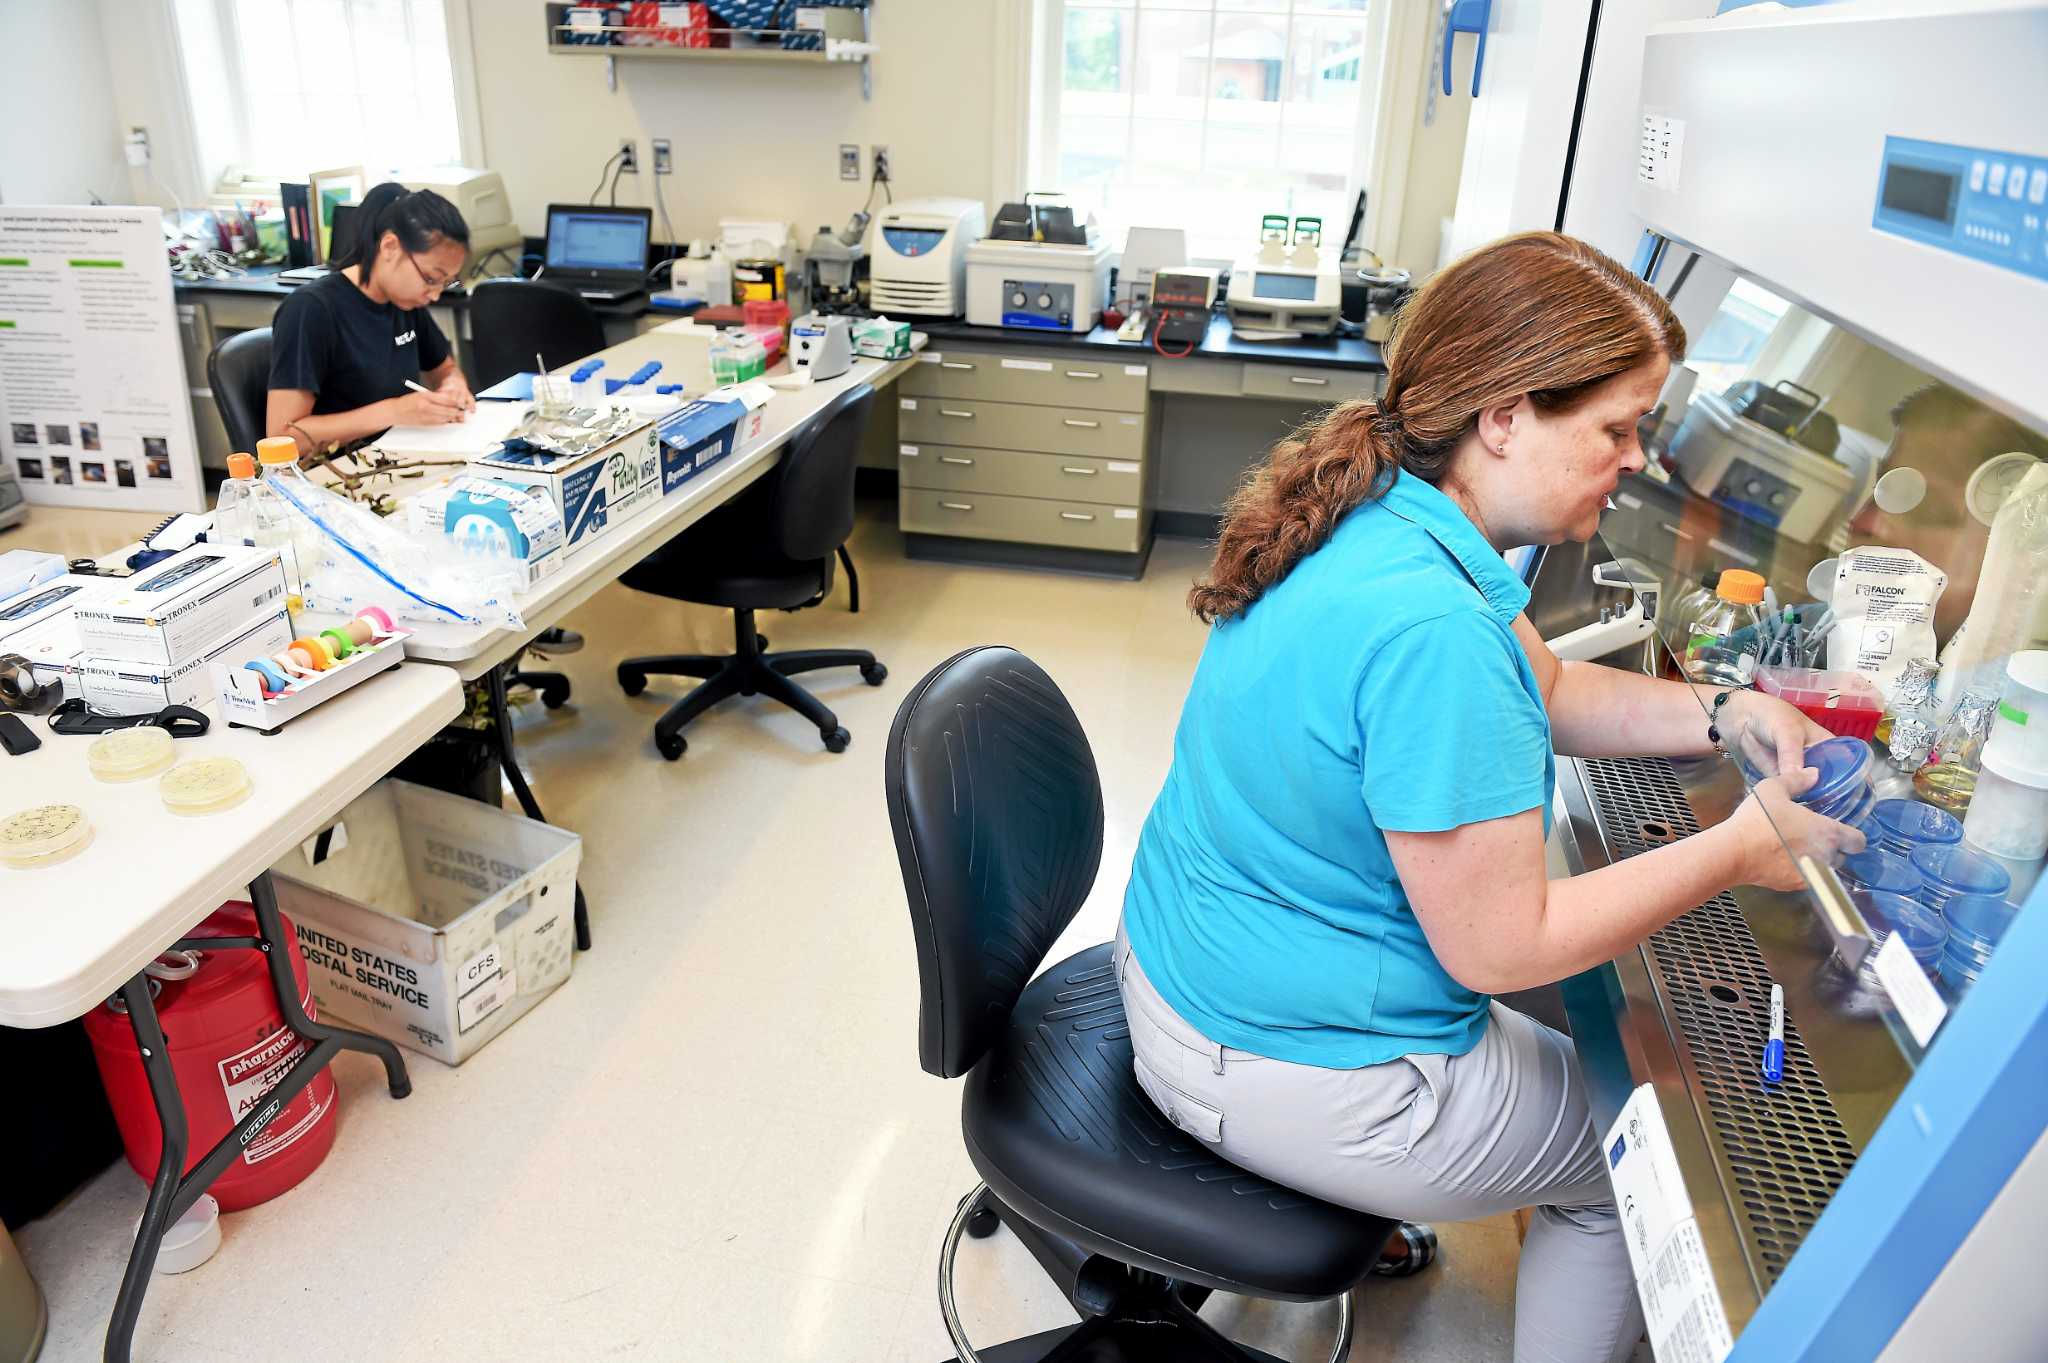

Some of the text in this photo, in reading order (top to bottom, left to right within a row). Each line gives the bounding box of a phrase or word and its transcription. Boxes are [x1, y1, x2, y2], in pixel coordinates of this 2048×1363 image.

[1871, 585, 1904, 596] FALCON
[79, 610, 110, 621] TRONEX
[166, 600, 198, 621] TRONEX
[86, 667, 117, 678] TRONEX
[171, 657, 202, 680] TRONEX
[299, 944, 429, 1009] OSTAL SERVICE
[351, 947, 418, 985] STATES
[468, 953, 495, 980] CFS
[230, 1031, 295, 1079] pharmco
[243, 1104, 277, 1140] LIFETIME
